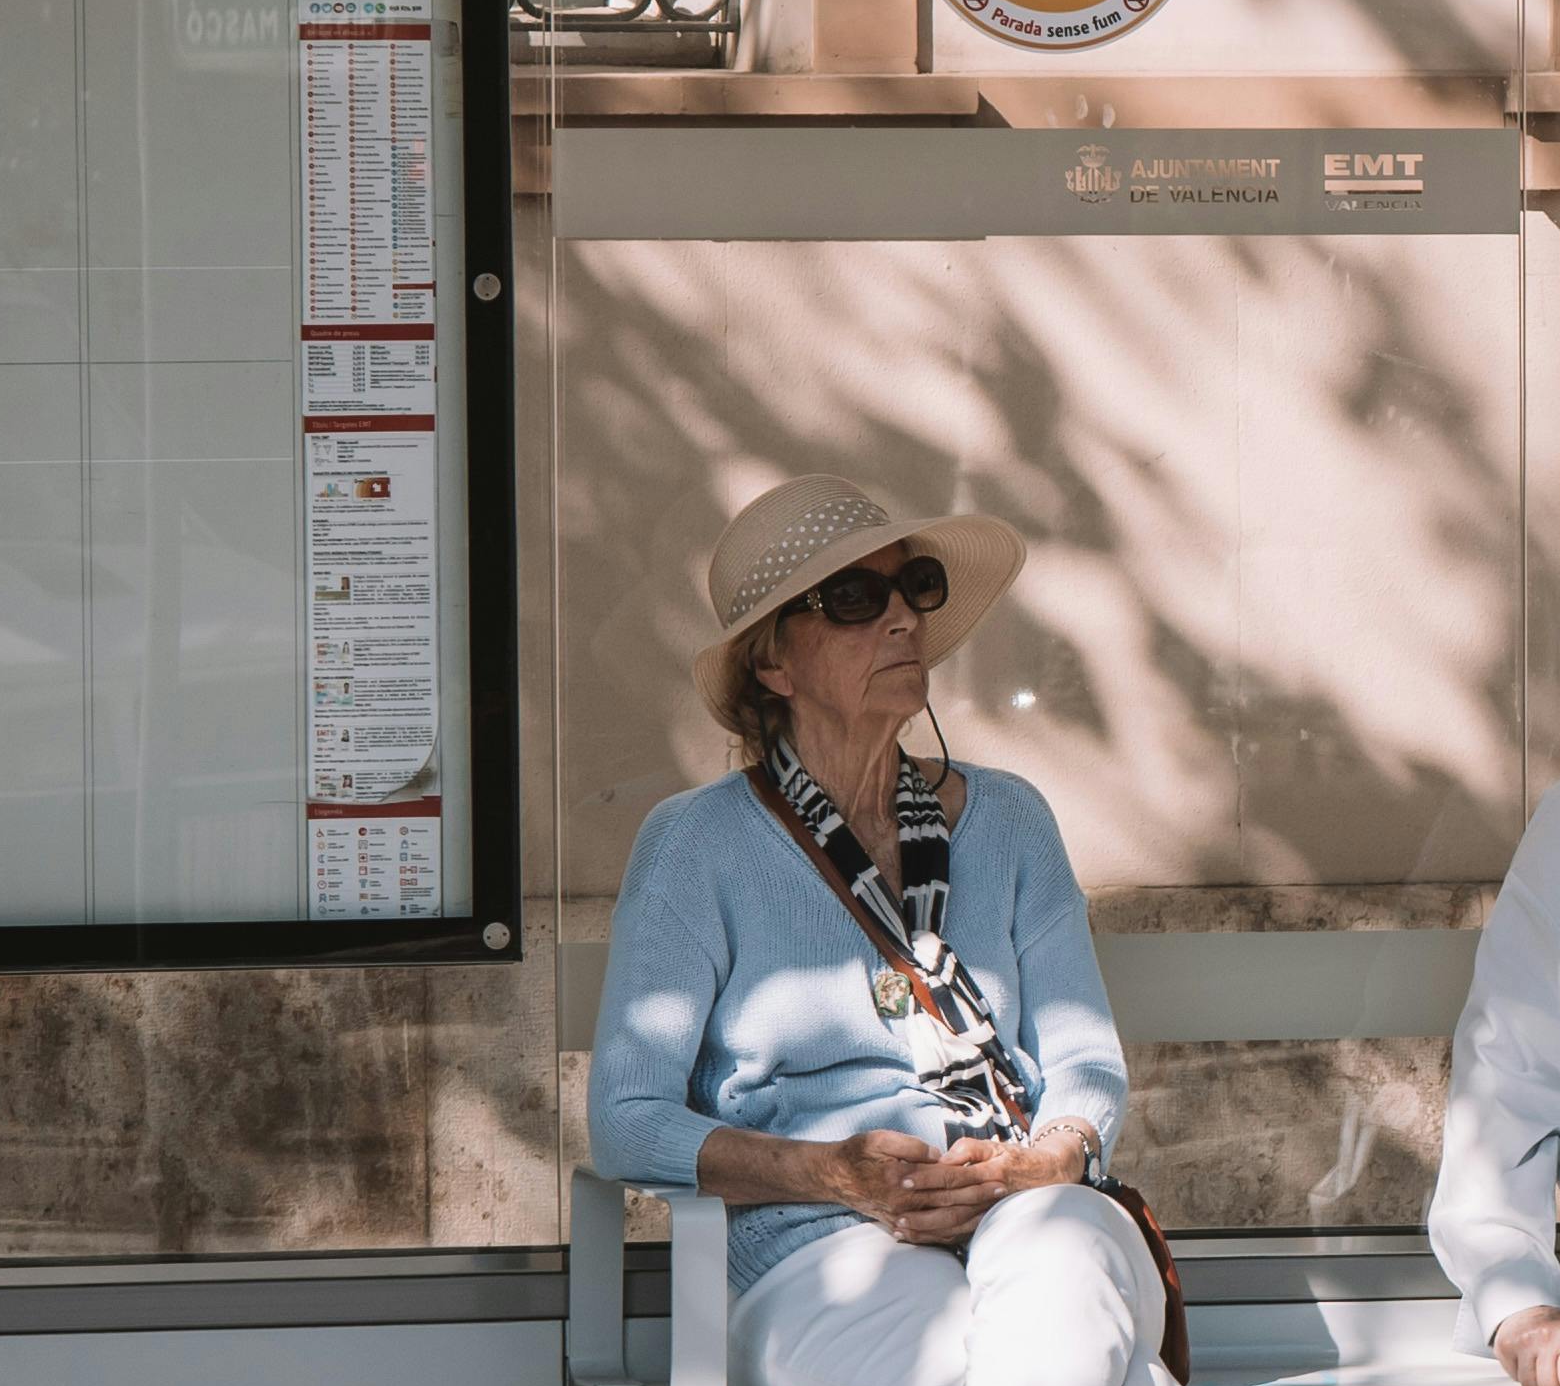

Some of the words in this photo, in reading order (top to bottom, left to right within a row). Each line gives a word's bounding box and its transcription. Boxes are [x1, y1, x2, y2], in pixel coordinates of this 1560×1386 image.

[991, 8, 1042, 36] Parada
[1047, 21, 1090, 38] sense
[1092, 10, 1122, 31] fum
[1130, 159, 1280, 179] AJUNTAMENT
[1324, 154, 1423, 176] EMT
[1130, 185, 1159, 203] DE
[1170, 185, 1280, 203] VALENCIA
[1324, 200, 1423, 211] VALENCIA
